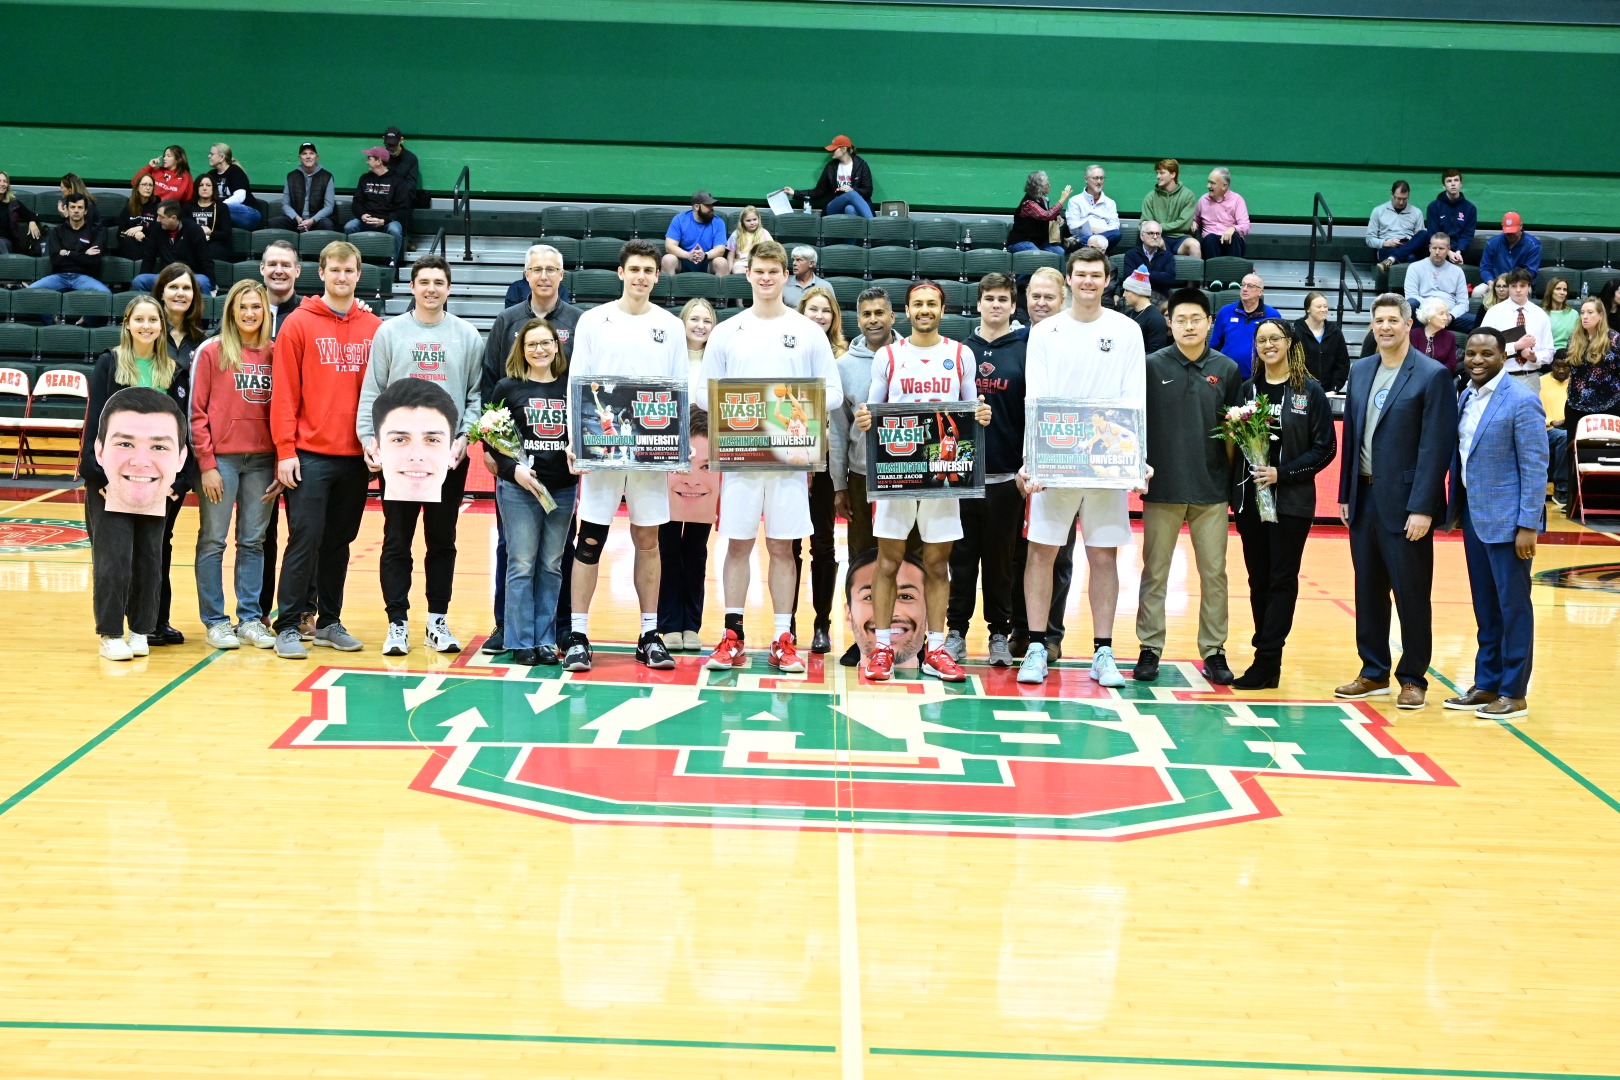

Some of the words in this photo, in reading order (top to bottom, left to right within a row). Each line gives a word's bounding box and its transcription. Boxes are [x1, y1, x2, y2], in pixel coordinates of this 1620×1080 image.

[411, 350, 447, 363] WASH
[0, 372, 22, 387] ARS
[45, 374, 81, 389] BEARS
[233, 373, 272, 391] WAS
[900, 377, 951, 394] WashU
[976, 378, 1009, 391] ASHU
[631, 400, 678, 418] WASH
[637, 391, 672, 429] U
[720, 402, 767, 419] WASH
[725, 392, 760, 431] U
[877, 425, 925, 445] WASH
[883, 415, 919, 456] U
[1039, 421, 1085, 438] WASH
[1044, 412, 1079, 449] U
[524, 439, 567, 451] BASKETBA
[583, 434, 634, 446] WASHINGTON
[635, 434, 679, 446] UNIVERSITY
[718, 435, 770, 447] WASHINGTON
[770, 435, 815, 446] UNIVERSITY
[876, 462, 927, 473] WASHINGTON
[929, 461, 974, 472] UNIVERSITY
[1037, 453, 1089, 465] WASHINGTON
[1089, 454, 1135, 465] UNIVERSITY
[275, 665, 1452, 785] WASH
